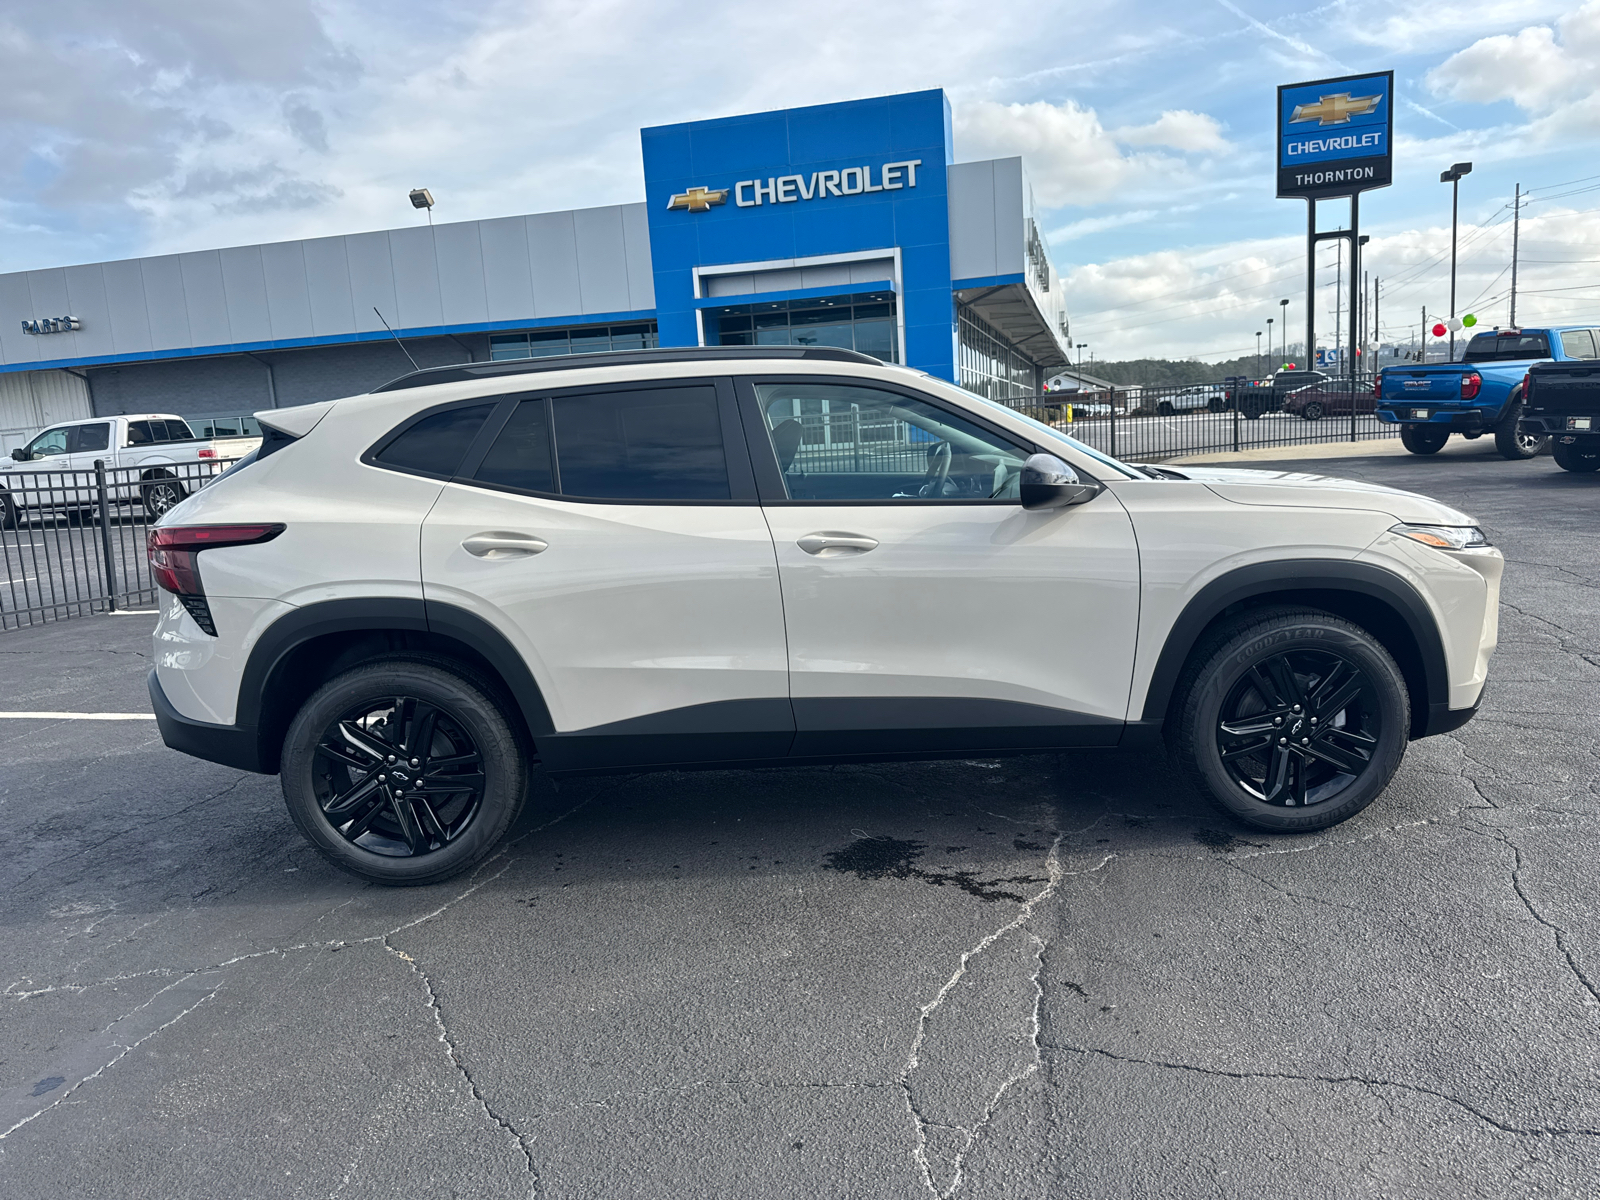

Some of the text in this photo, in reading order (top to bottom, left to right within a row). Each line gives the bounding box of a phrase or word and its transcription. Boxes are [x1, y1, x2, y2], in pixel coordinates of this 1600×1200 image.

[1287, 132, 1382, 155] CHEVROLET
[735, 159, 922, 208] CHEVROLET
[1295, 166, 1374, 186] THORNTON
[21, 315, 80, 335] PARTS
[1236, 629, 1325, 664] GOODYEAR
